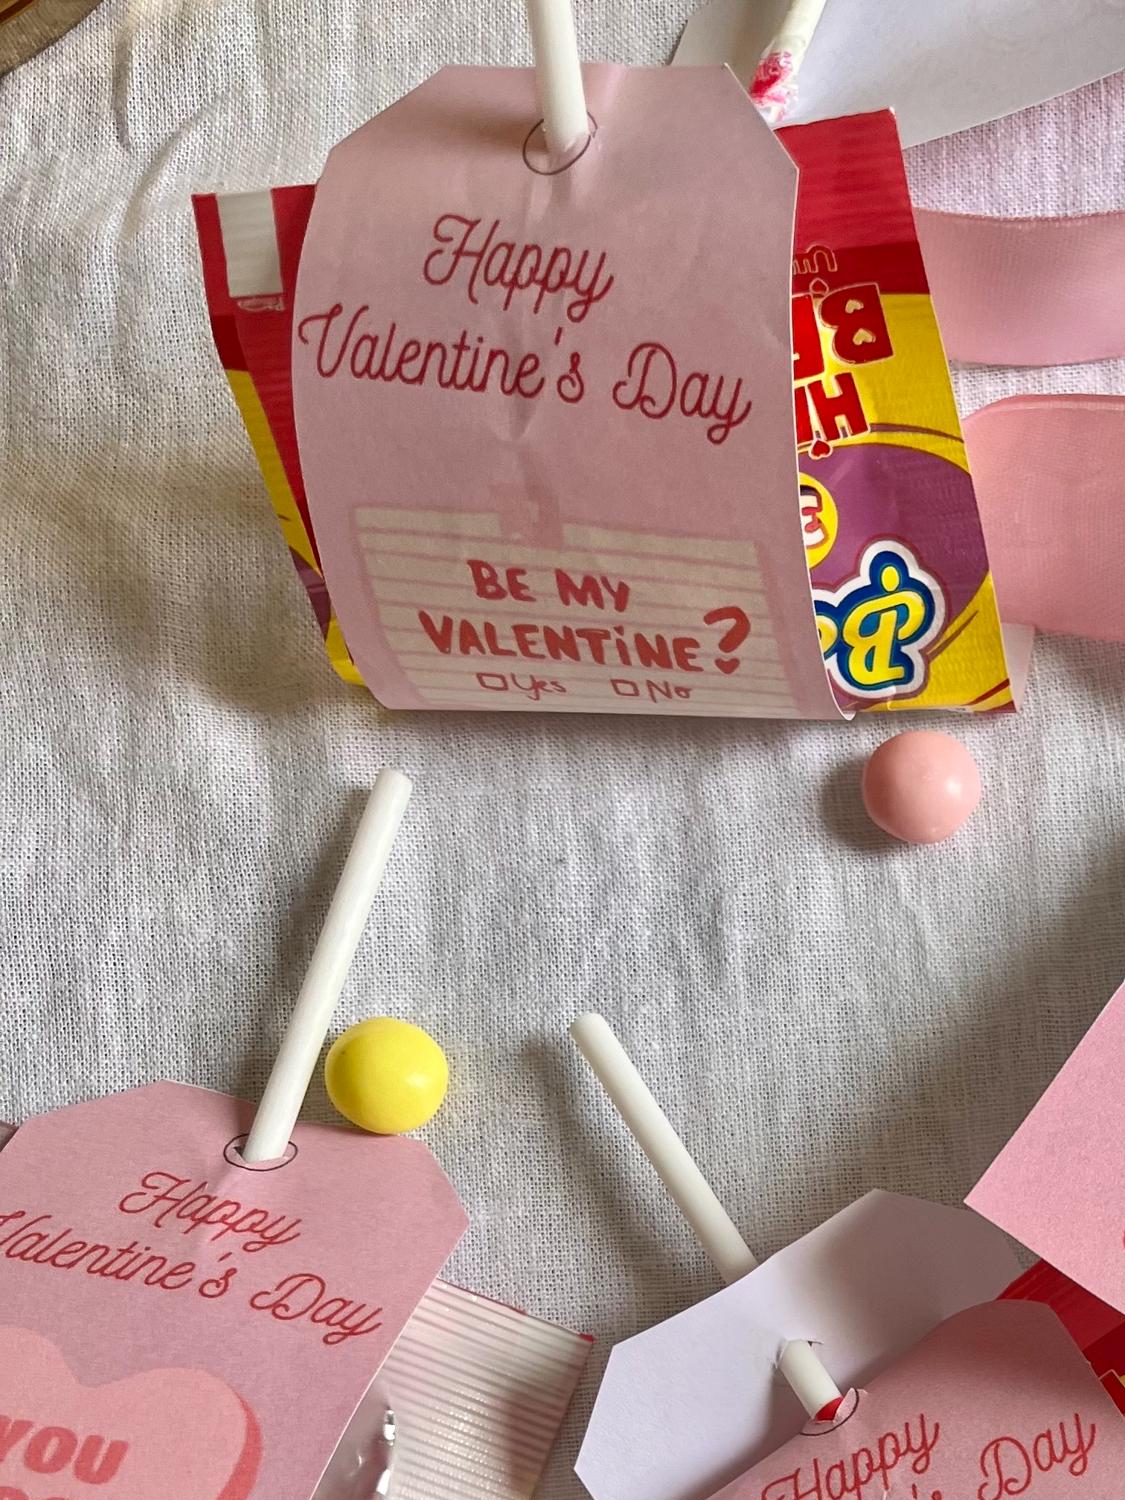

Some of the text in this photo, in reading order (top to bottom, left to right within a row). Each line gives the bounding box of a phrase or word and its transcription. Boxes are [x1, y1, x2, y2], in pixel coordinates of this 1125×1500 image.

[422, 214, 613, 322] Happy
[298, 306, 752, 445] Valentine's Day
[470, 560, 629, 614] BE MY
[510, 673, 691, 703] Yes No
[119, 1172, 302, 1253] Happy
[250, 1274, 383, 1345] Day
